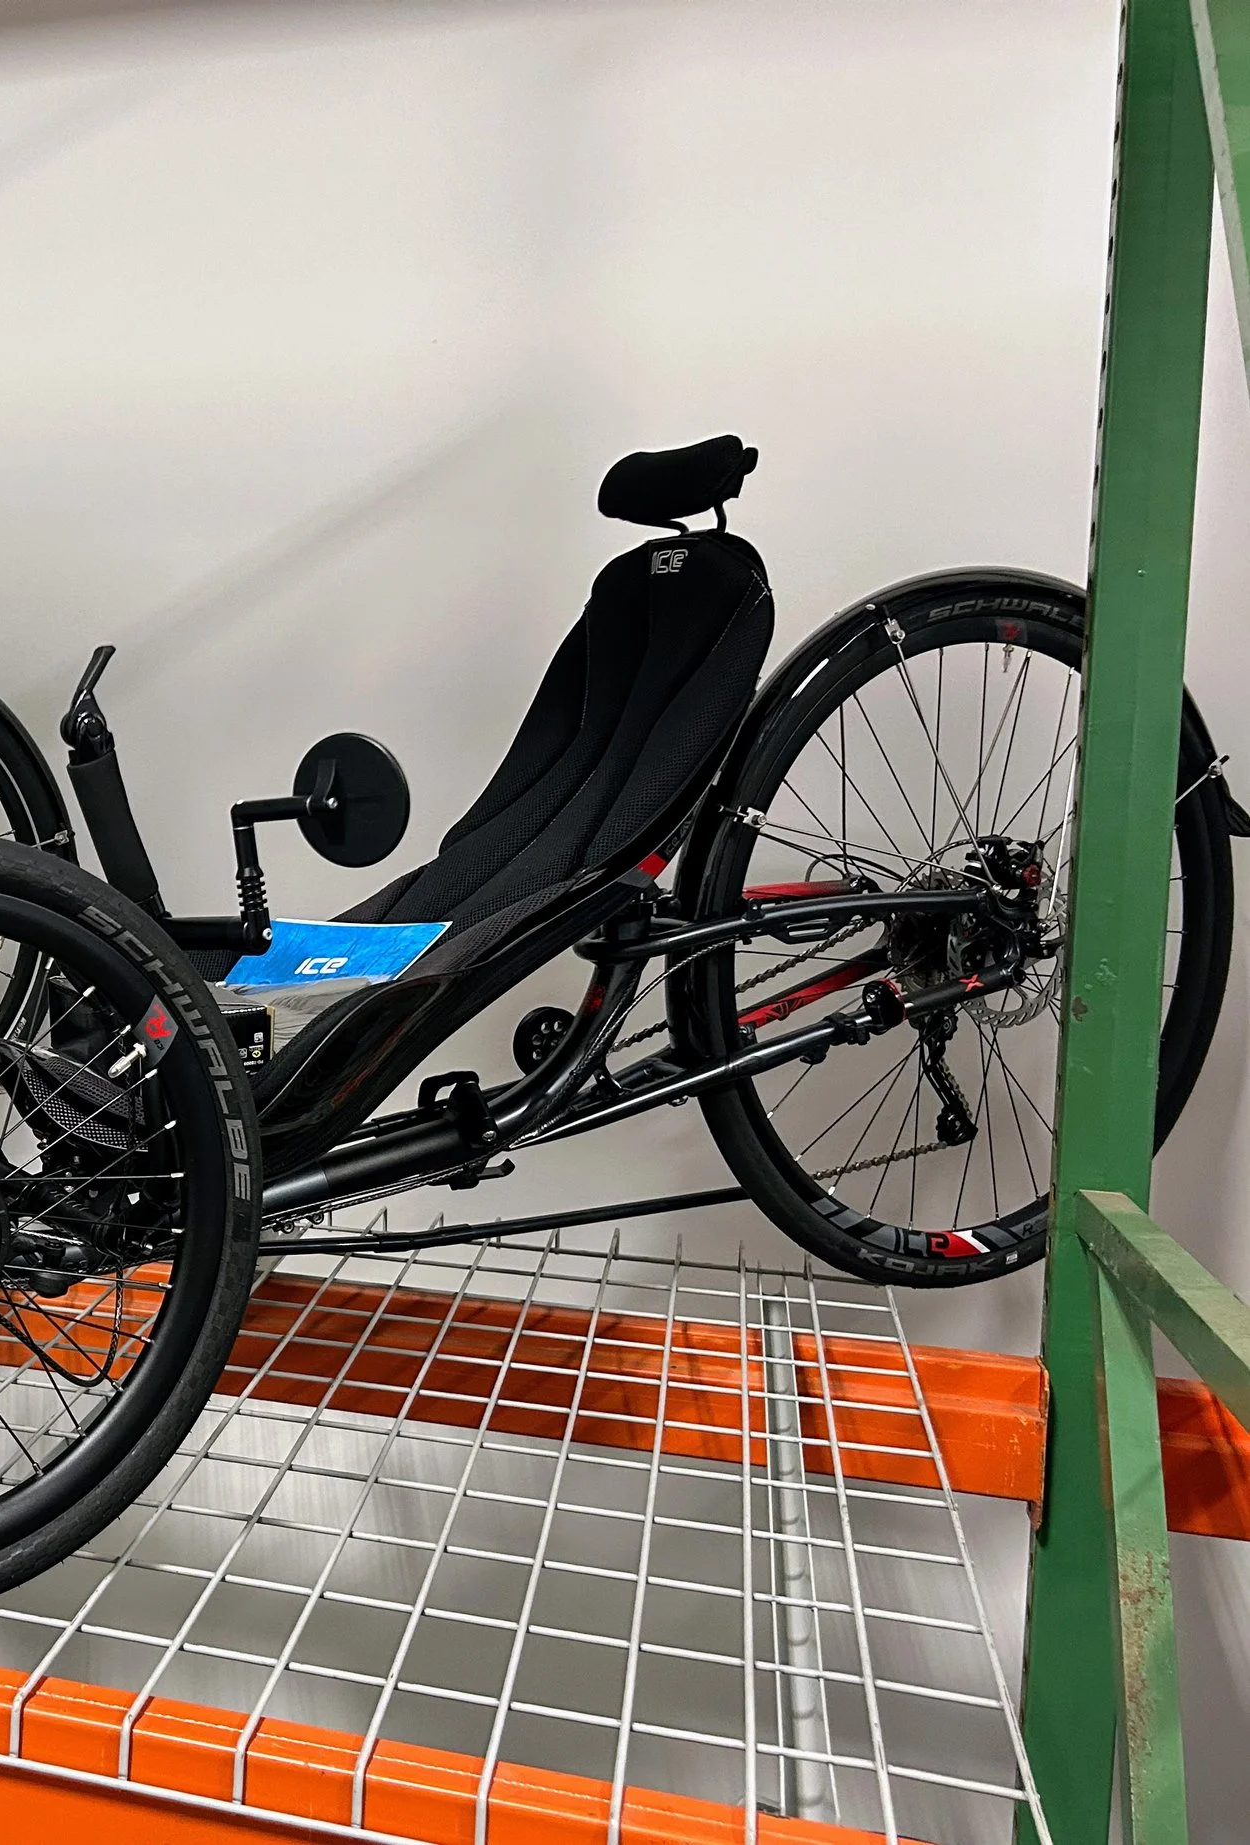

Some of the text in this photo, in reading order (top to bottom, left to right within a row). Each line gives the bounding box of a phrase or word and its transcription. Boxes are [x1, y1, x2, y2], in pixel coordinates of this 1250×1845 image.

[927, 597, 1086, 628] SCHWALB
[78, 905, 251, 1201] SCHWALBE
[857, 1248, 998, 1277] KOJAK
